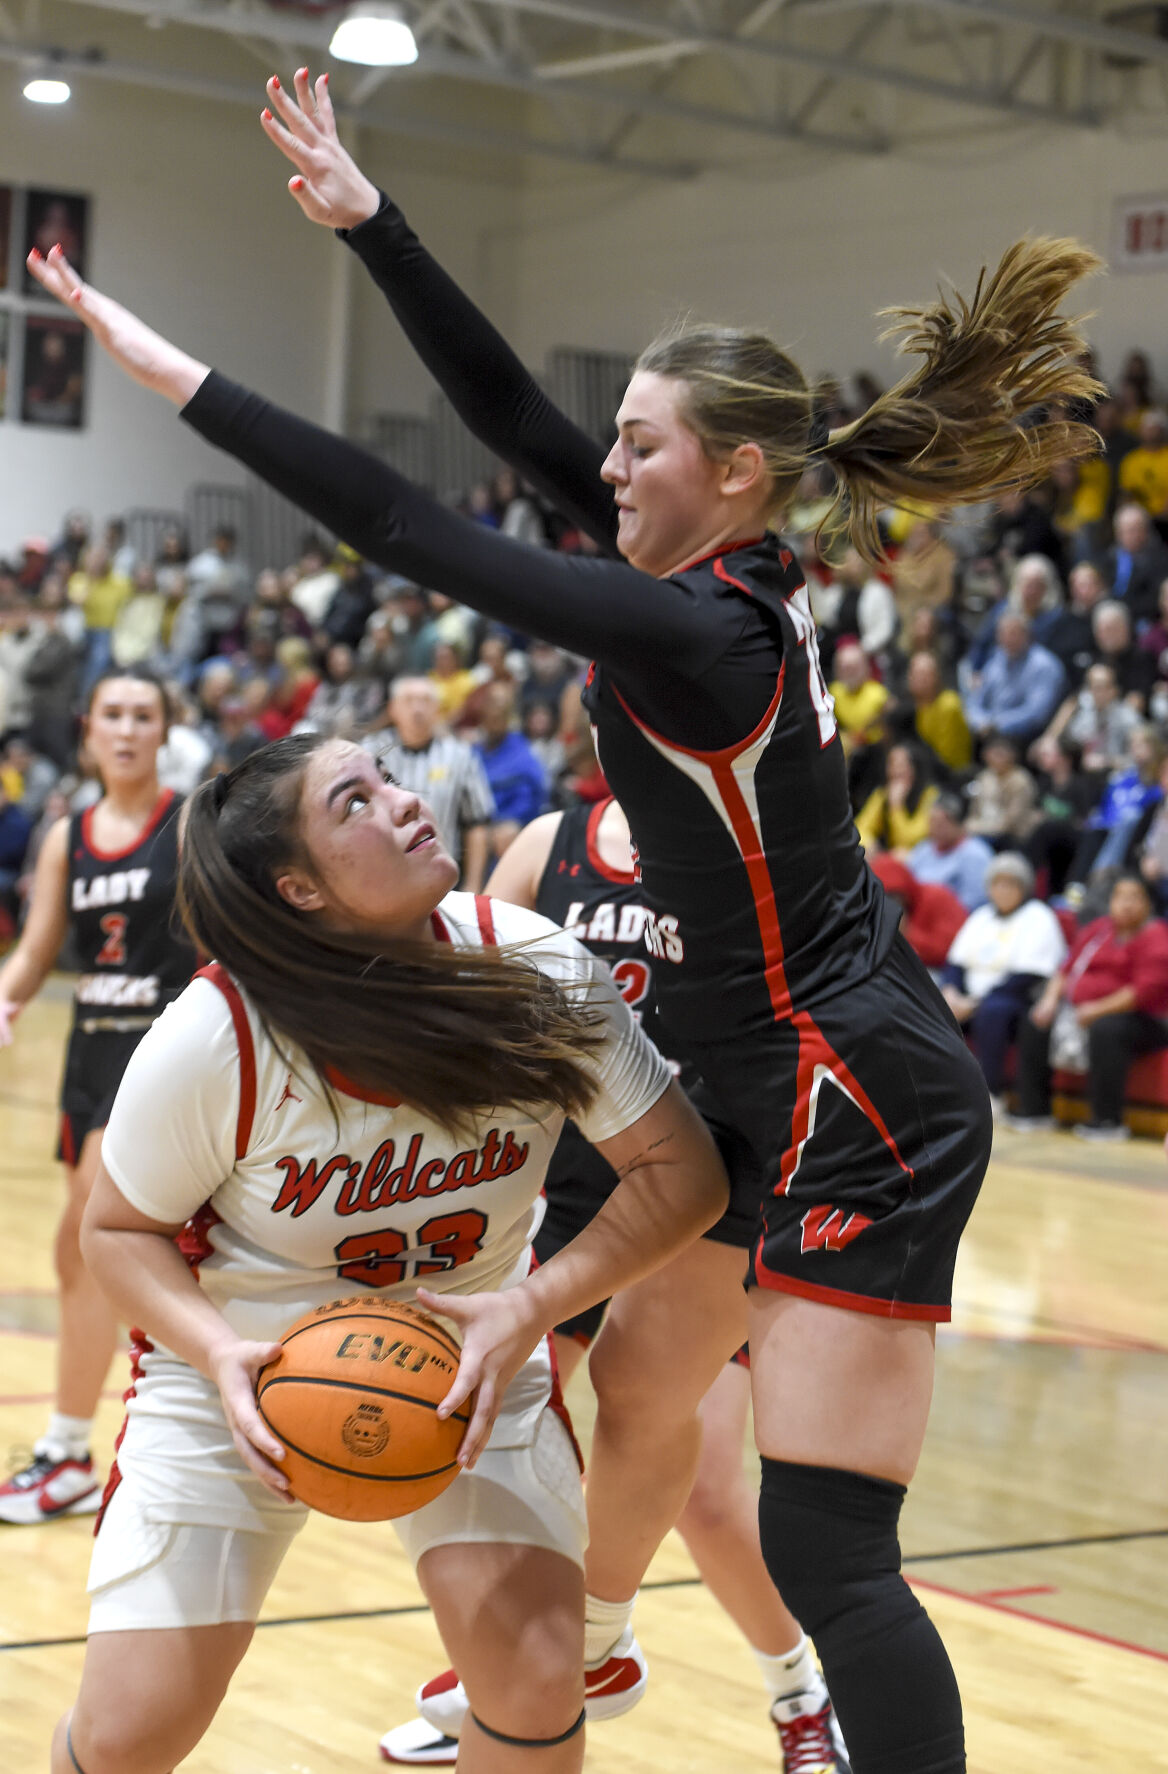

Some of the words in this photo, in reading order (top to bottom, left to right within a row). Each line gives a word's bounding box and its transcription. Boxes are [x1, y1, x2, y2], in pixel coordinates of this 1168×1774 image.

[71, 867, 152, 912] LADY
[94, 911, 128, 966] 2
[564, 901, 648, 944] LAD
[271, 1128, 529, 1218] Wildcats
[336, 1332, 430, 1375] EVO
